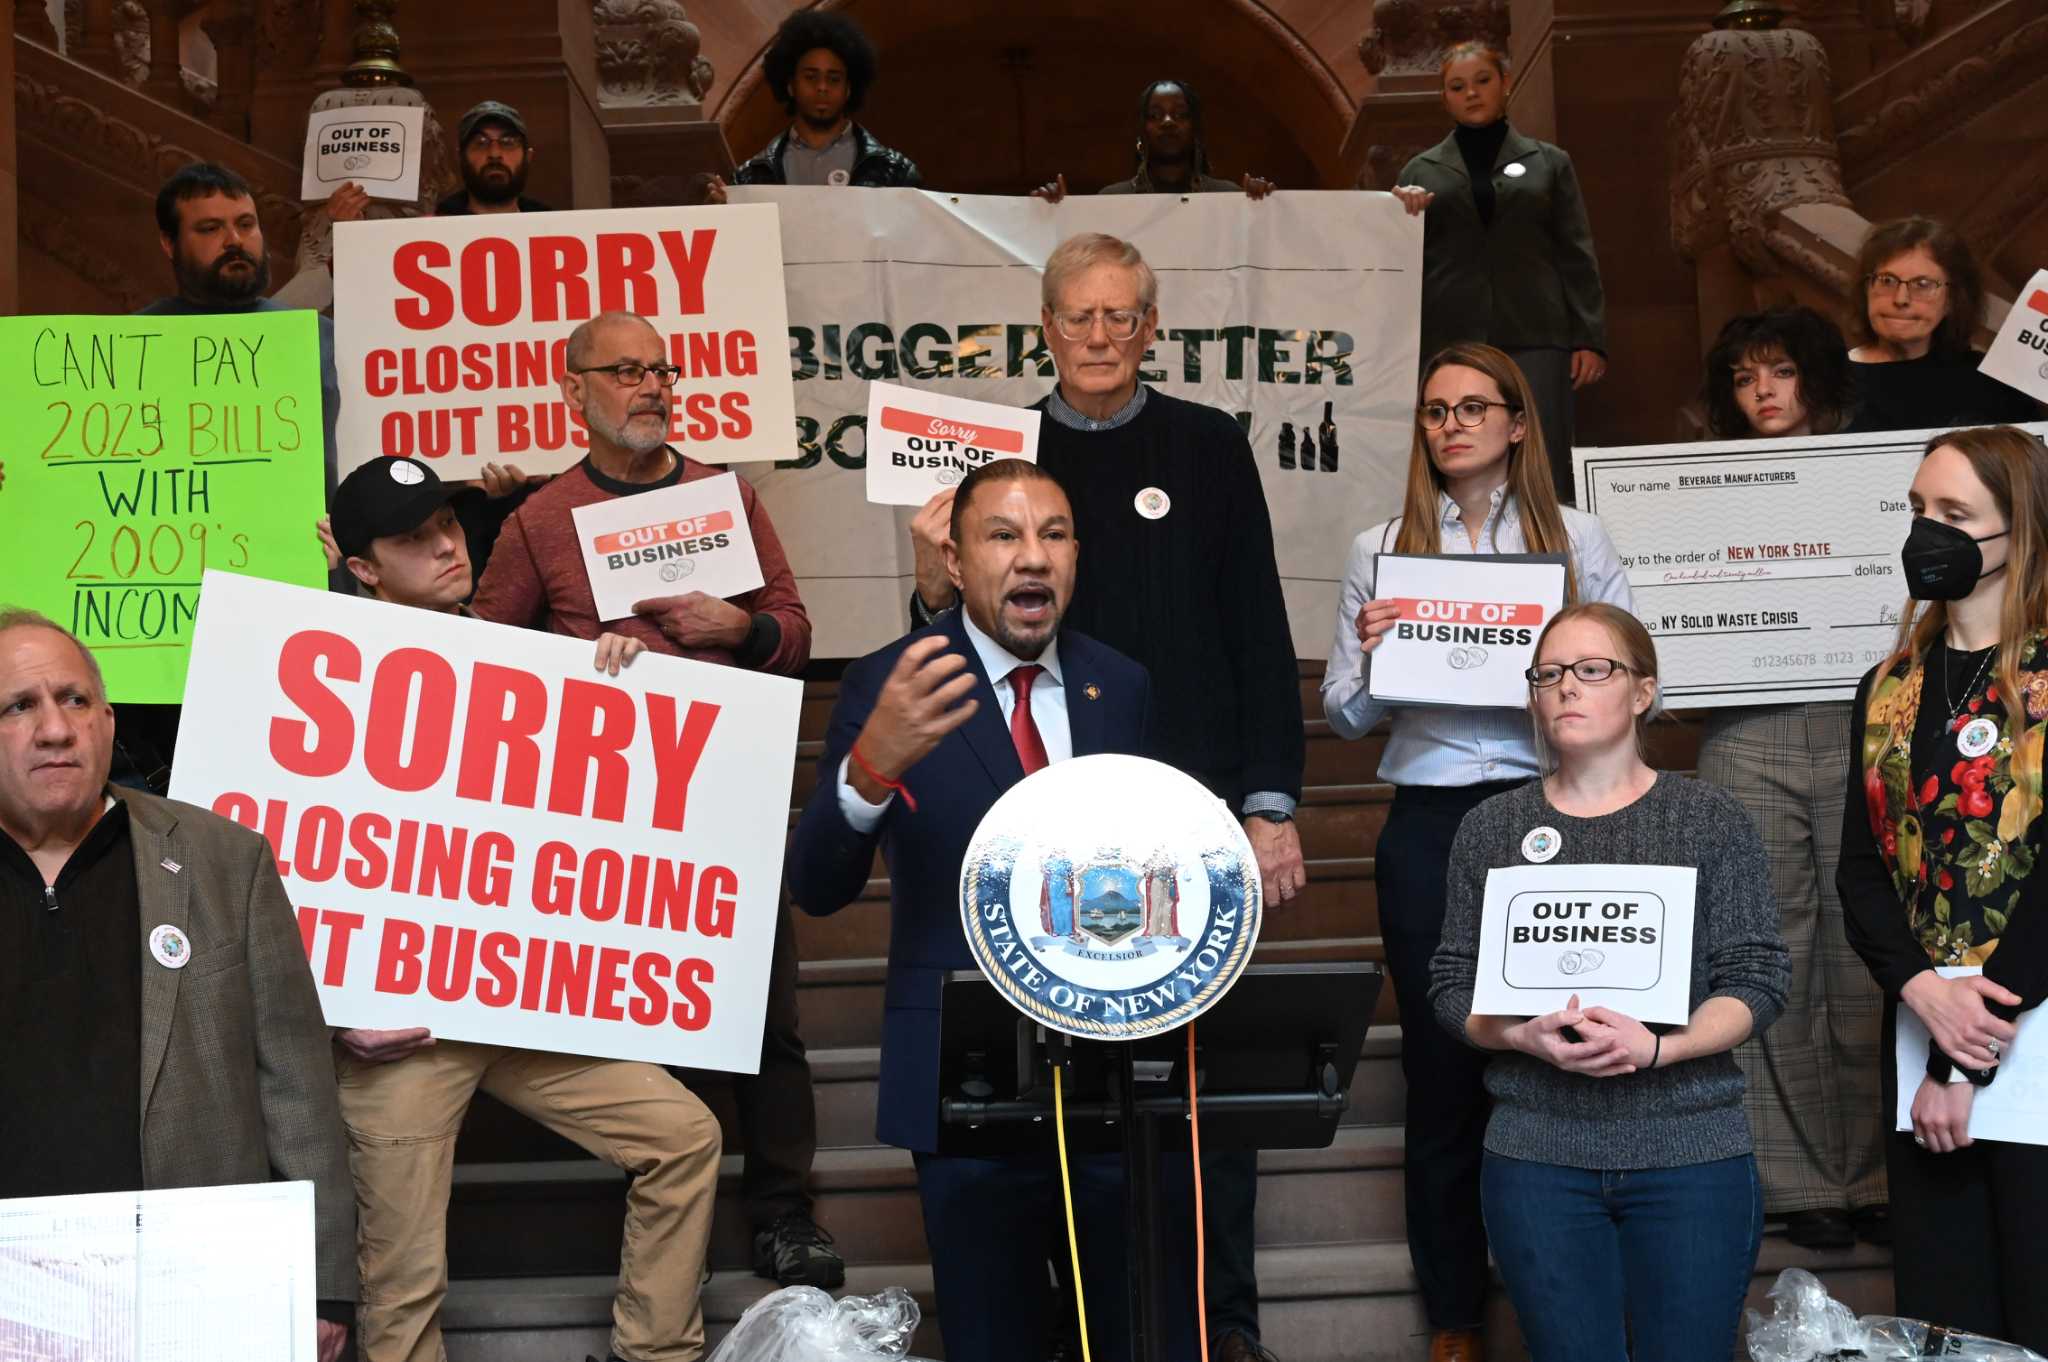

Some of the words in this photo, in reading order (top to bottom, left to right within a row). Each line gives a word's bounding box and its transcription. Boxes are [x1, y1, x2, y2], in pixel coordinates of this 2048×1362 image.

[321, 142, 401, 155] BUSINESS
[331, 128, 364, 140] OUT
[369, 128, 391, 138] OF
[393, 229, 718, 330] SORRY
[34, 327, 163, 391] CAN'T
[193, 334, 265, 389] PAY
[669, 329, 758, 379] ING
[788, 323, 1057, 380] BIGGER
[188, 395, 301, 457] BILLS
[381, 406, 483, 459] OUT
[498, 391, 753, 454] BUSESS
[928, 418, 978, 445] Sorry
[907, 436, 958, 453] OUT
[964, 447, 995, 464] OF
[98, 468, 210, 517] WITH
[1610, 482, 1636, 493] Your
[1639, 481, 1671, 492] name
[1679, 475, 1722, 486] BEVERAGE
[1724, 471, 1796, 484] MANUFACTURERS
[1880, 501, 1907, 512] Date
[618, 525, 669, 548] OUT
[676, 516, 709, 536] OF
[66, 520, 249, 579] 2009's
[607, 533, 730, 570] BUSINESS
[1619, 555, 1635, 568] ay
[1638, 555, 1650, 565] to
[1653, 552, 1671, 564] the
[1674, 551, 1706, 563] order
[1708, 549, 1721, 561] of
[1728, 546, 1754, 560] NEW
[1758, 544, 1790, 559] YORK
[1793, 542, 1831, 556] STATE
[1855, 564, 1893, 576] dollars
[72, 589, 200, 640] INCOM
[1416, 600, 1473, 620] OUT
[1481, 604, 1517, 622] OF
[1662, 615, 1677, 630] NY
[1681, 614, 1713, 629] SOLID
[1717, 612, 1757, 627] WASTE
[1761, 611, 1798, 625] CRISIS
[1398, 623, 1532, 646] BUSINESS
[268, 629, 722, 832] SORRY
[531, 840, 738, 938] GOING
[1533, 902, 1592, 919] OUT
[1601, 902, 1639, 919] OF
[1512, 926, 1657, 944] BUSINESS
[984, 902, 1048, 992] STATE
[1049, 985, 1096, 1014] OF
[1103, 981, 1177, 1017] NEW
[1182, 904, 1238, 988] YORK
[1077, 948, 1145, 961] EXCELSIOR
[375, 918, 714, 1031] BUSINESS
